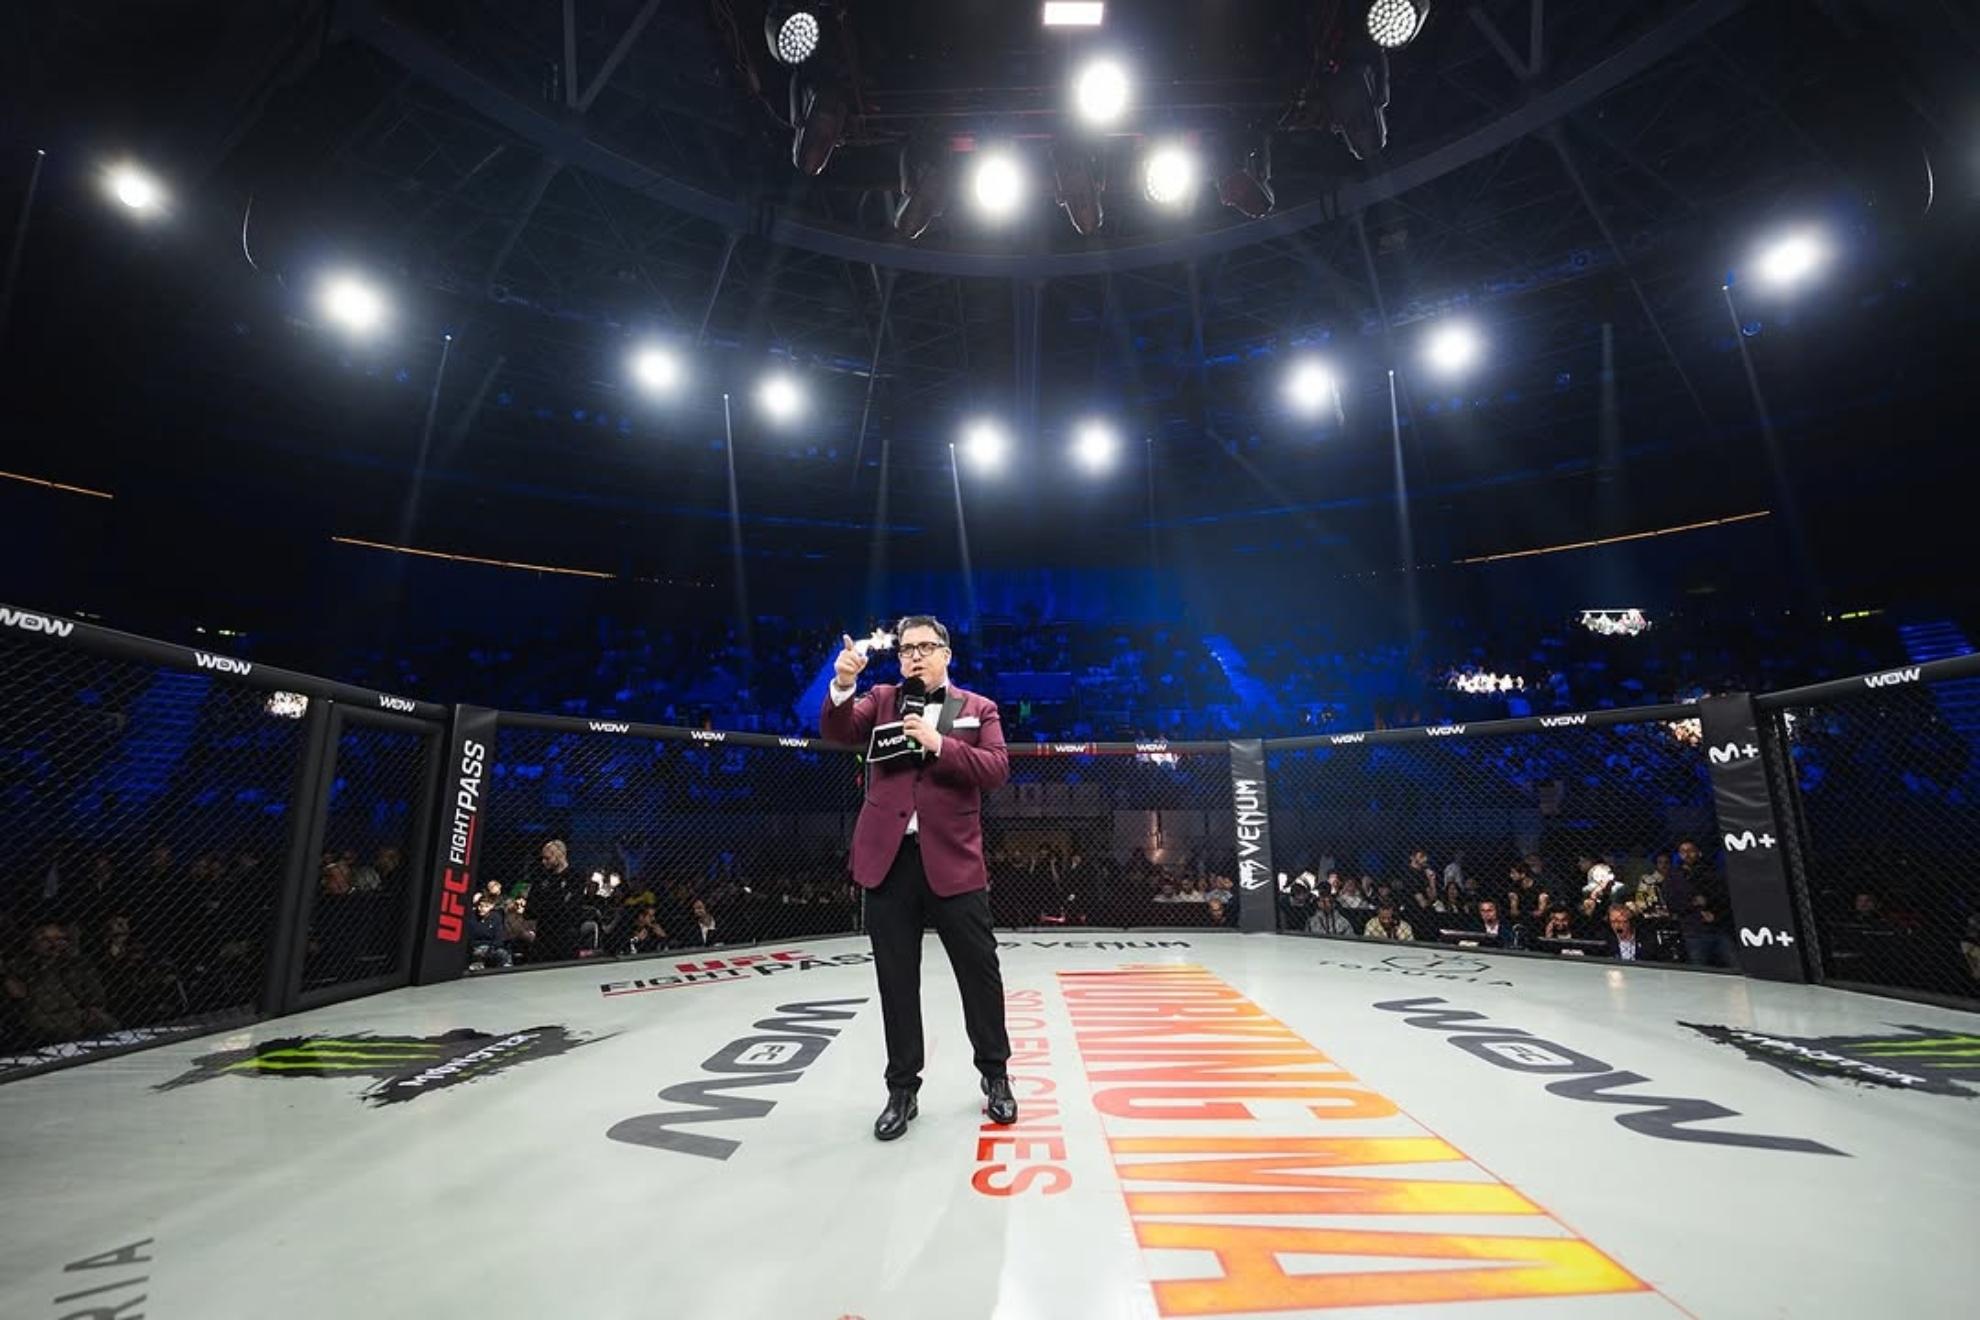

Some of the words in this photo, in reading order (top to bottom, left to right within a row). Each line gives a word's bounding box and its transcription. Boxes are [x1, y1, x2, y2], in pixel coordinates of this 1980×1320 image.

[195, 652, 251, 675] WOW
[1865, 667, 1921, 687] WOW
[379, 695, 415, 712] WOW
[589, 721, 630, 733] WOW
[1426, 725, 1465, 736] WOW
[1540, 714, 1587, 727] WOW
[691, 730, 725, 741] WOW
[779, 737, 809, 747] WOW
[1331, 733, 1365, 744] WOW
[1055, 744, 1085, 753] WOW
[1136, 743, 1167, 751] WOW
[457, 740, 485, 811] PASS
[1234, 780, 1268, 857] VENUM
[450, 808, 470, 865] FIGHT
[437, 868, 470, 942] UFC
[1032, 941, 1190, 950] VENUM
[675, 950, 814, 972] UFC
[601, 968, 746, 992] FIGHT
[752, 952, 874, 976] PAS
[1056, 971, 1402, 1121] WORKING
[605, 997, 870, 1161] WOW
[1372, 997, 1856, 1157] WOW
